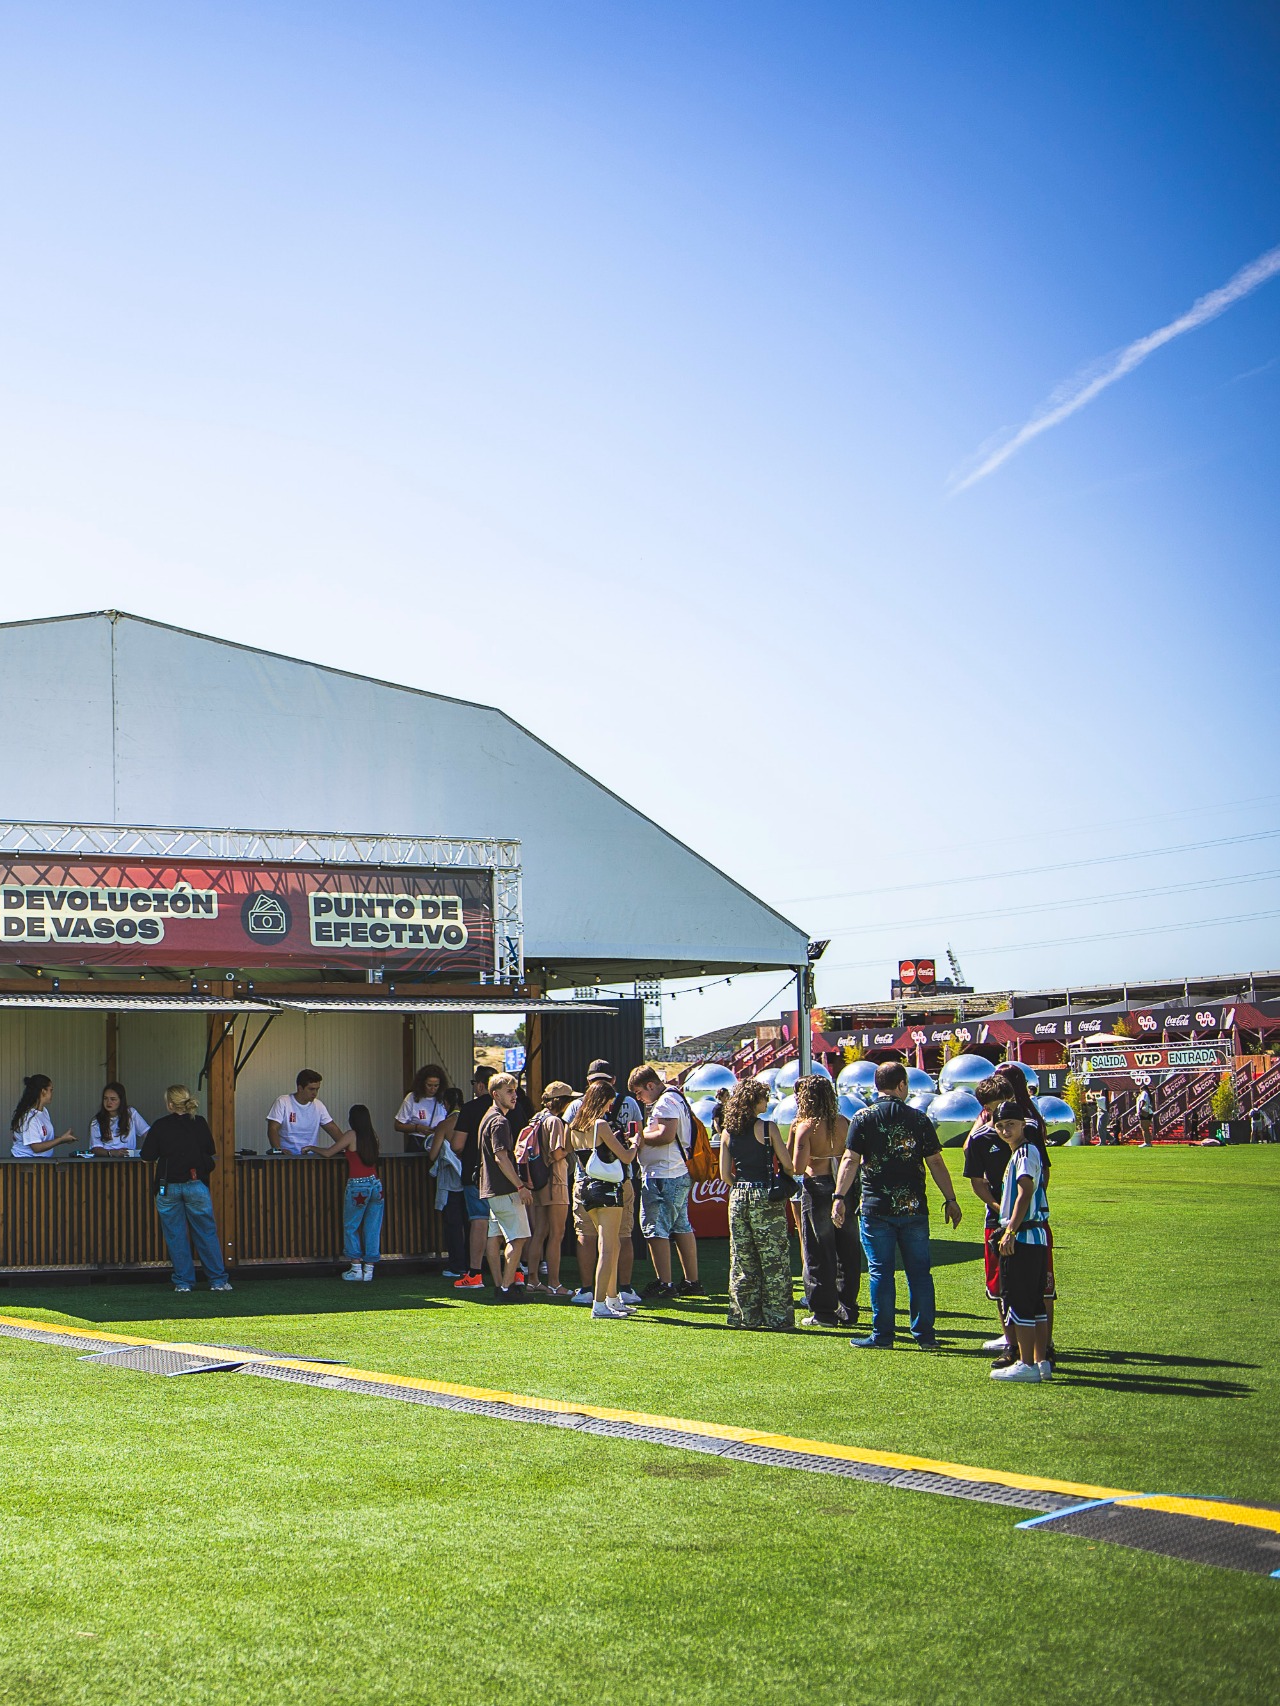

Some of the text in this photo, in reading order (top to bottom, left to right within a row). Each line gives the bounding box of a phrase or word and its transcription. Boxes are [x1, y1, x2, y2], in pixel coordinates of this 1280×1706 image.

[3, 887, 214, 914] DEVOLUCIÓN
[313, 897, 458, 920] PUNTO DE
[4, 917, 160, 939] DE VASOS
[314, 922, 464, 945] EFECTIVO
[1035, 1022, 1057, 1035] Coca-Cola
[1078, 1019, 1102, 1032] Coca-Cola
[1165, 1014, 1190, 1027] Coca-Cola
[1091, 1051, 1217, 1069] SALIDA VIP ENTRADA
